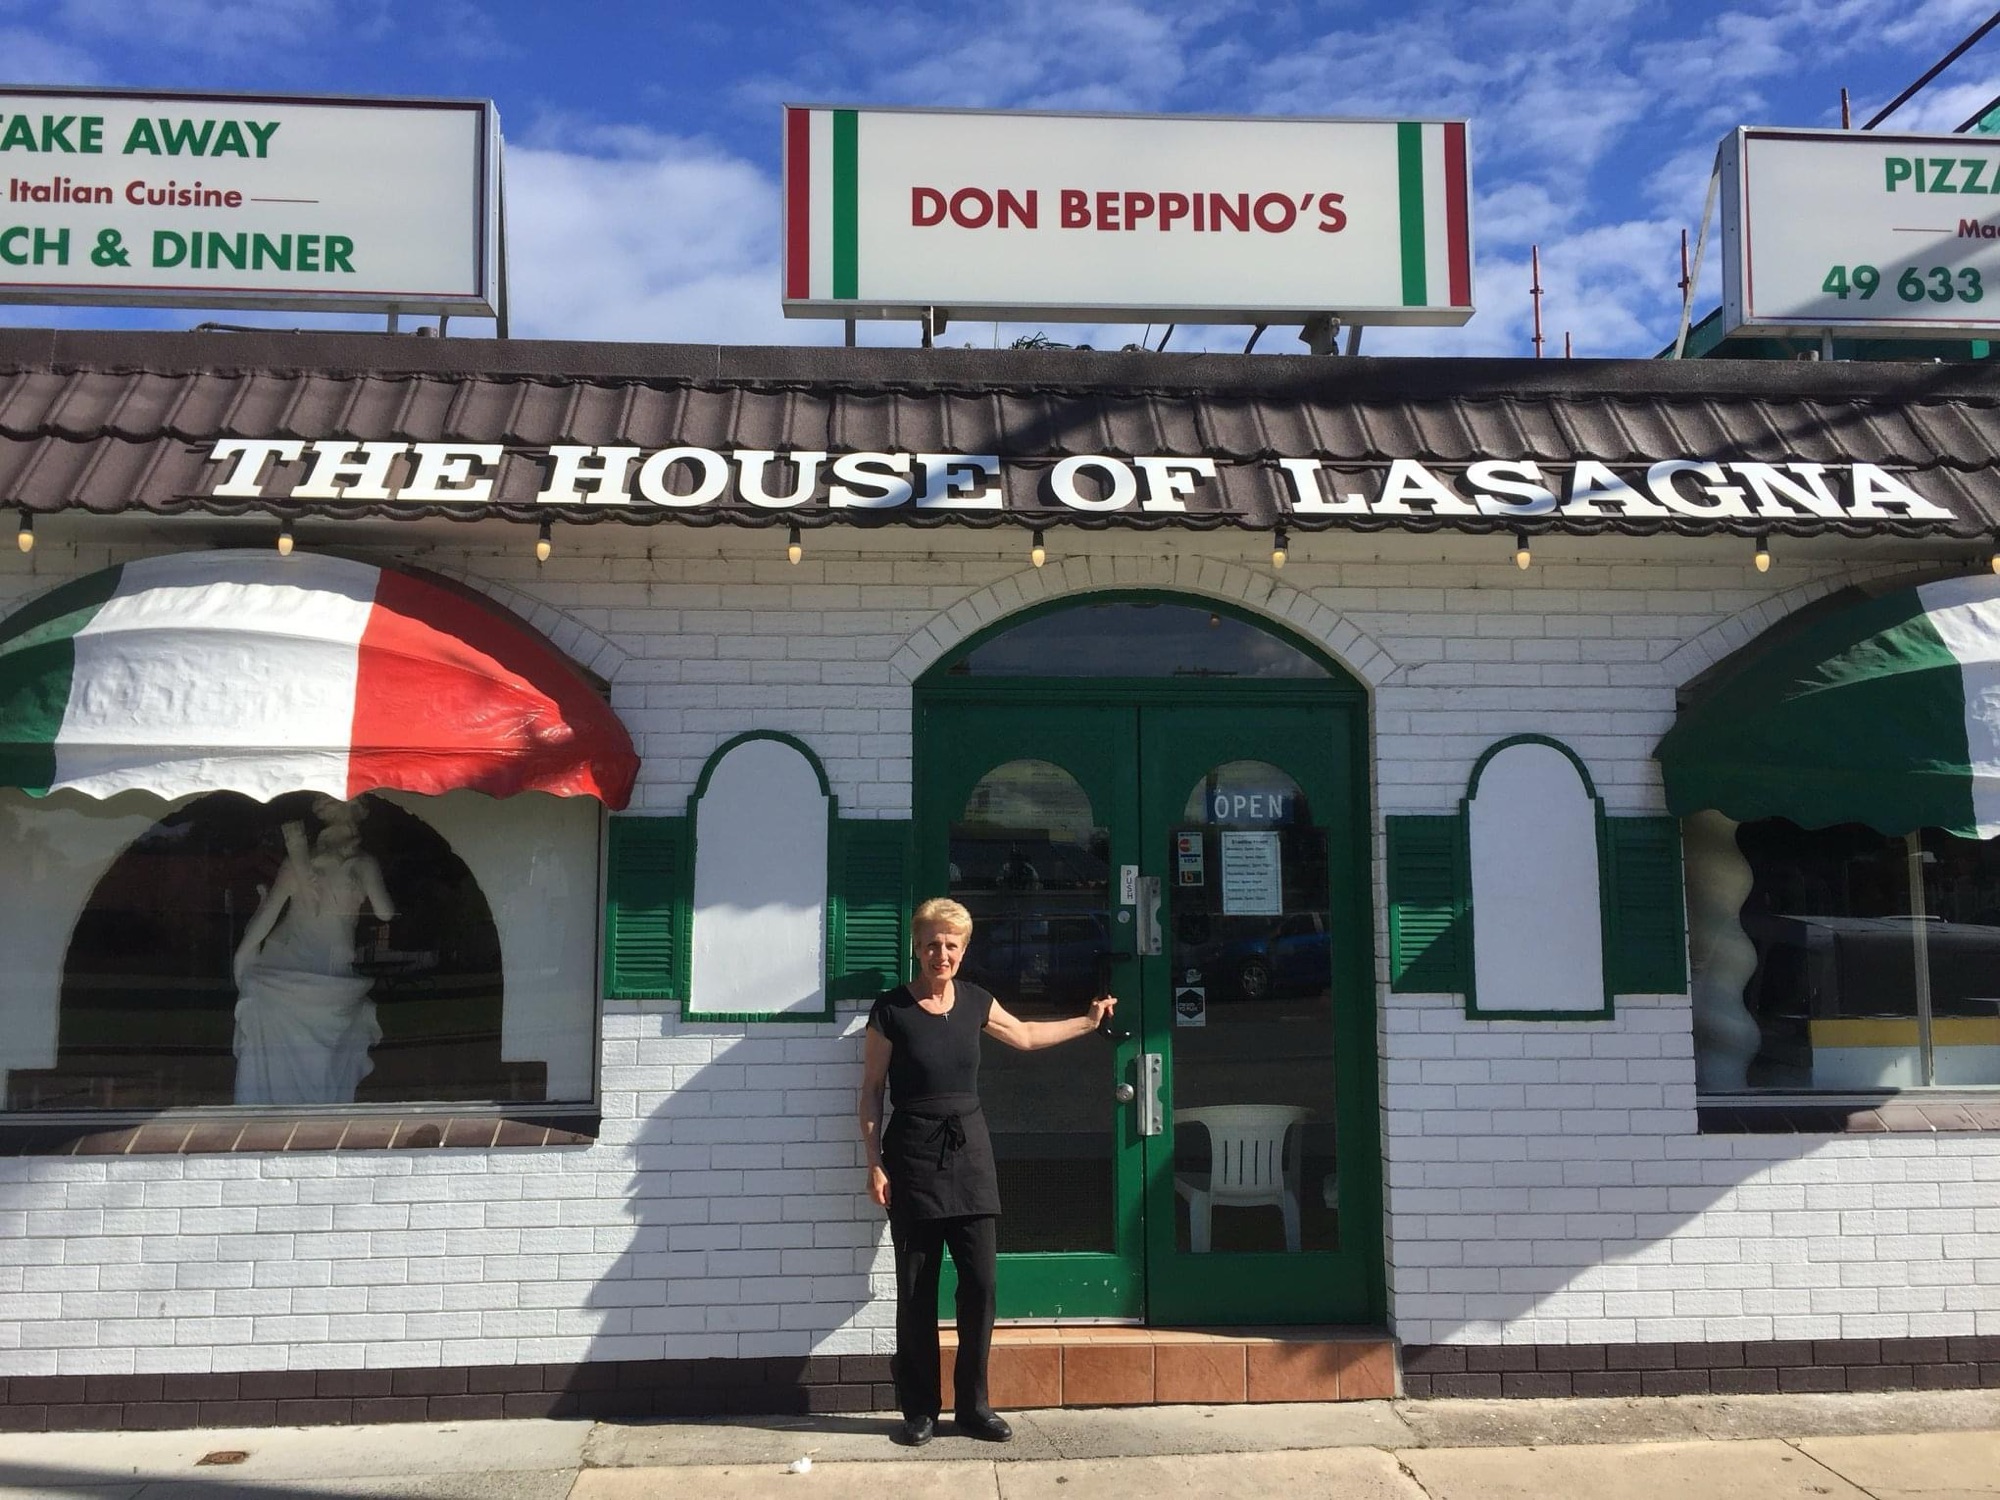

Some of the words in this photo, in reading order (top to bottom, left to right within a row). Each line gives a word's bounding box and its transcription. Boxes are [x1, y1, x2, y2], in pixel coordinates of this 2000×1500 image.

[0, 114, 103, 153] AKE
[122, 118, 281, 158] AWAY
[9, 176, 113, 205] Italian
[125, 180, 243, 207] Cuisine
[1885, 157, 2000, 194] PIZZ
[911, 187, 1037, 230] DON
[1060, 189, 1347, 233] BEPPINO’S
[1958, 219, 2000, 238] Ma
[90, 228, 132, 268] &
[153, 230, 356, 273] DINNER
[1822, 265, 1881, 300] 49
[1897, 267, 1983, 303] 633
[209, 438, 504, 503] THE
[536, 445, 1002, 510] HOUSE
[1049, 452, 1217, 514] OF
[1278, 457, 1957, 521] LASAGNA
[1214, 794, 1283, 819] OPEN
